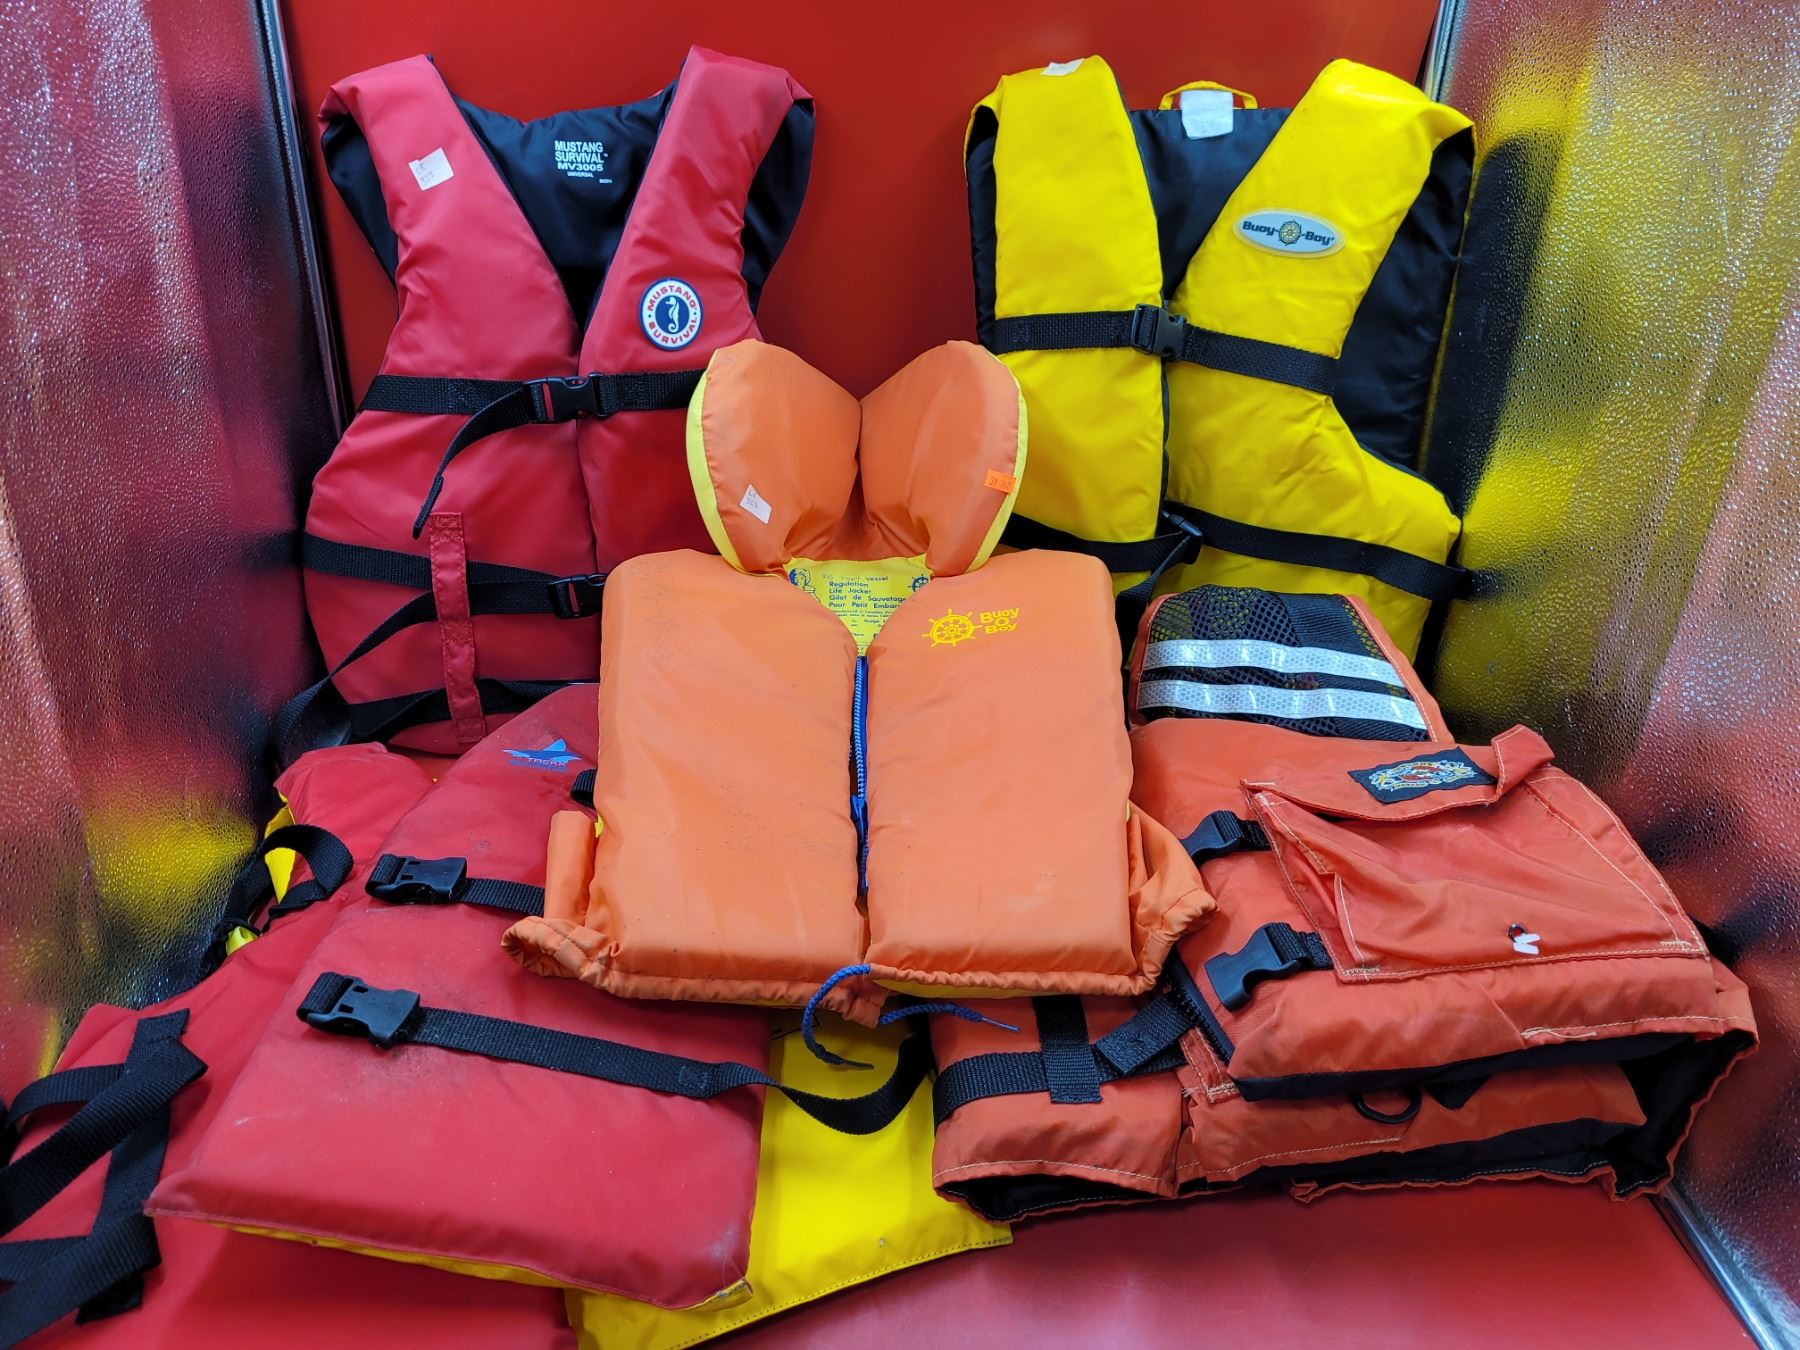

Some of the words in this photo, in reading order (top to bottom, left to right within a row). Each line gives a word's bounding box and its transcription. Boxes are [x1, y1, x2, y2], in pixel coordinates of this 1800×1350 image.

[554, 140, 604, 152] MUSTANG
[554, 151, 605, 163] SURVIVAL
[557, 162, 604, 172] MV3005
[1242, 221, 1275, 236] Buoy
[1304, 231, 1335, 246] Boy
[647, 285, 697, 311] MUSTANG
[648, 317, 698, 344] SURVIVAL
[980, 607, 1020, 624] Buoy
[985, 622, 1018, 635] Boy
